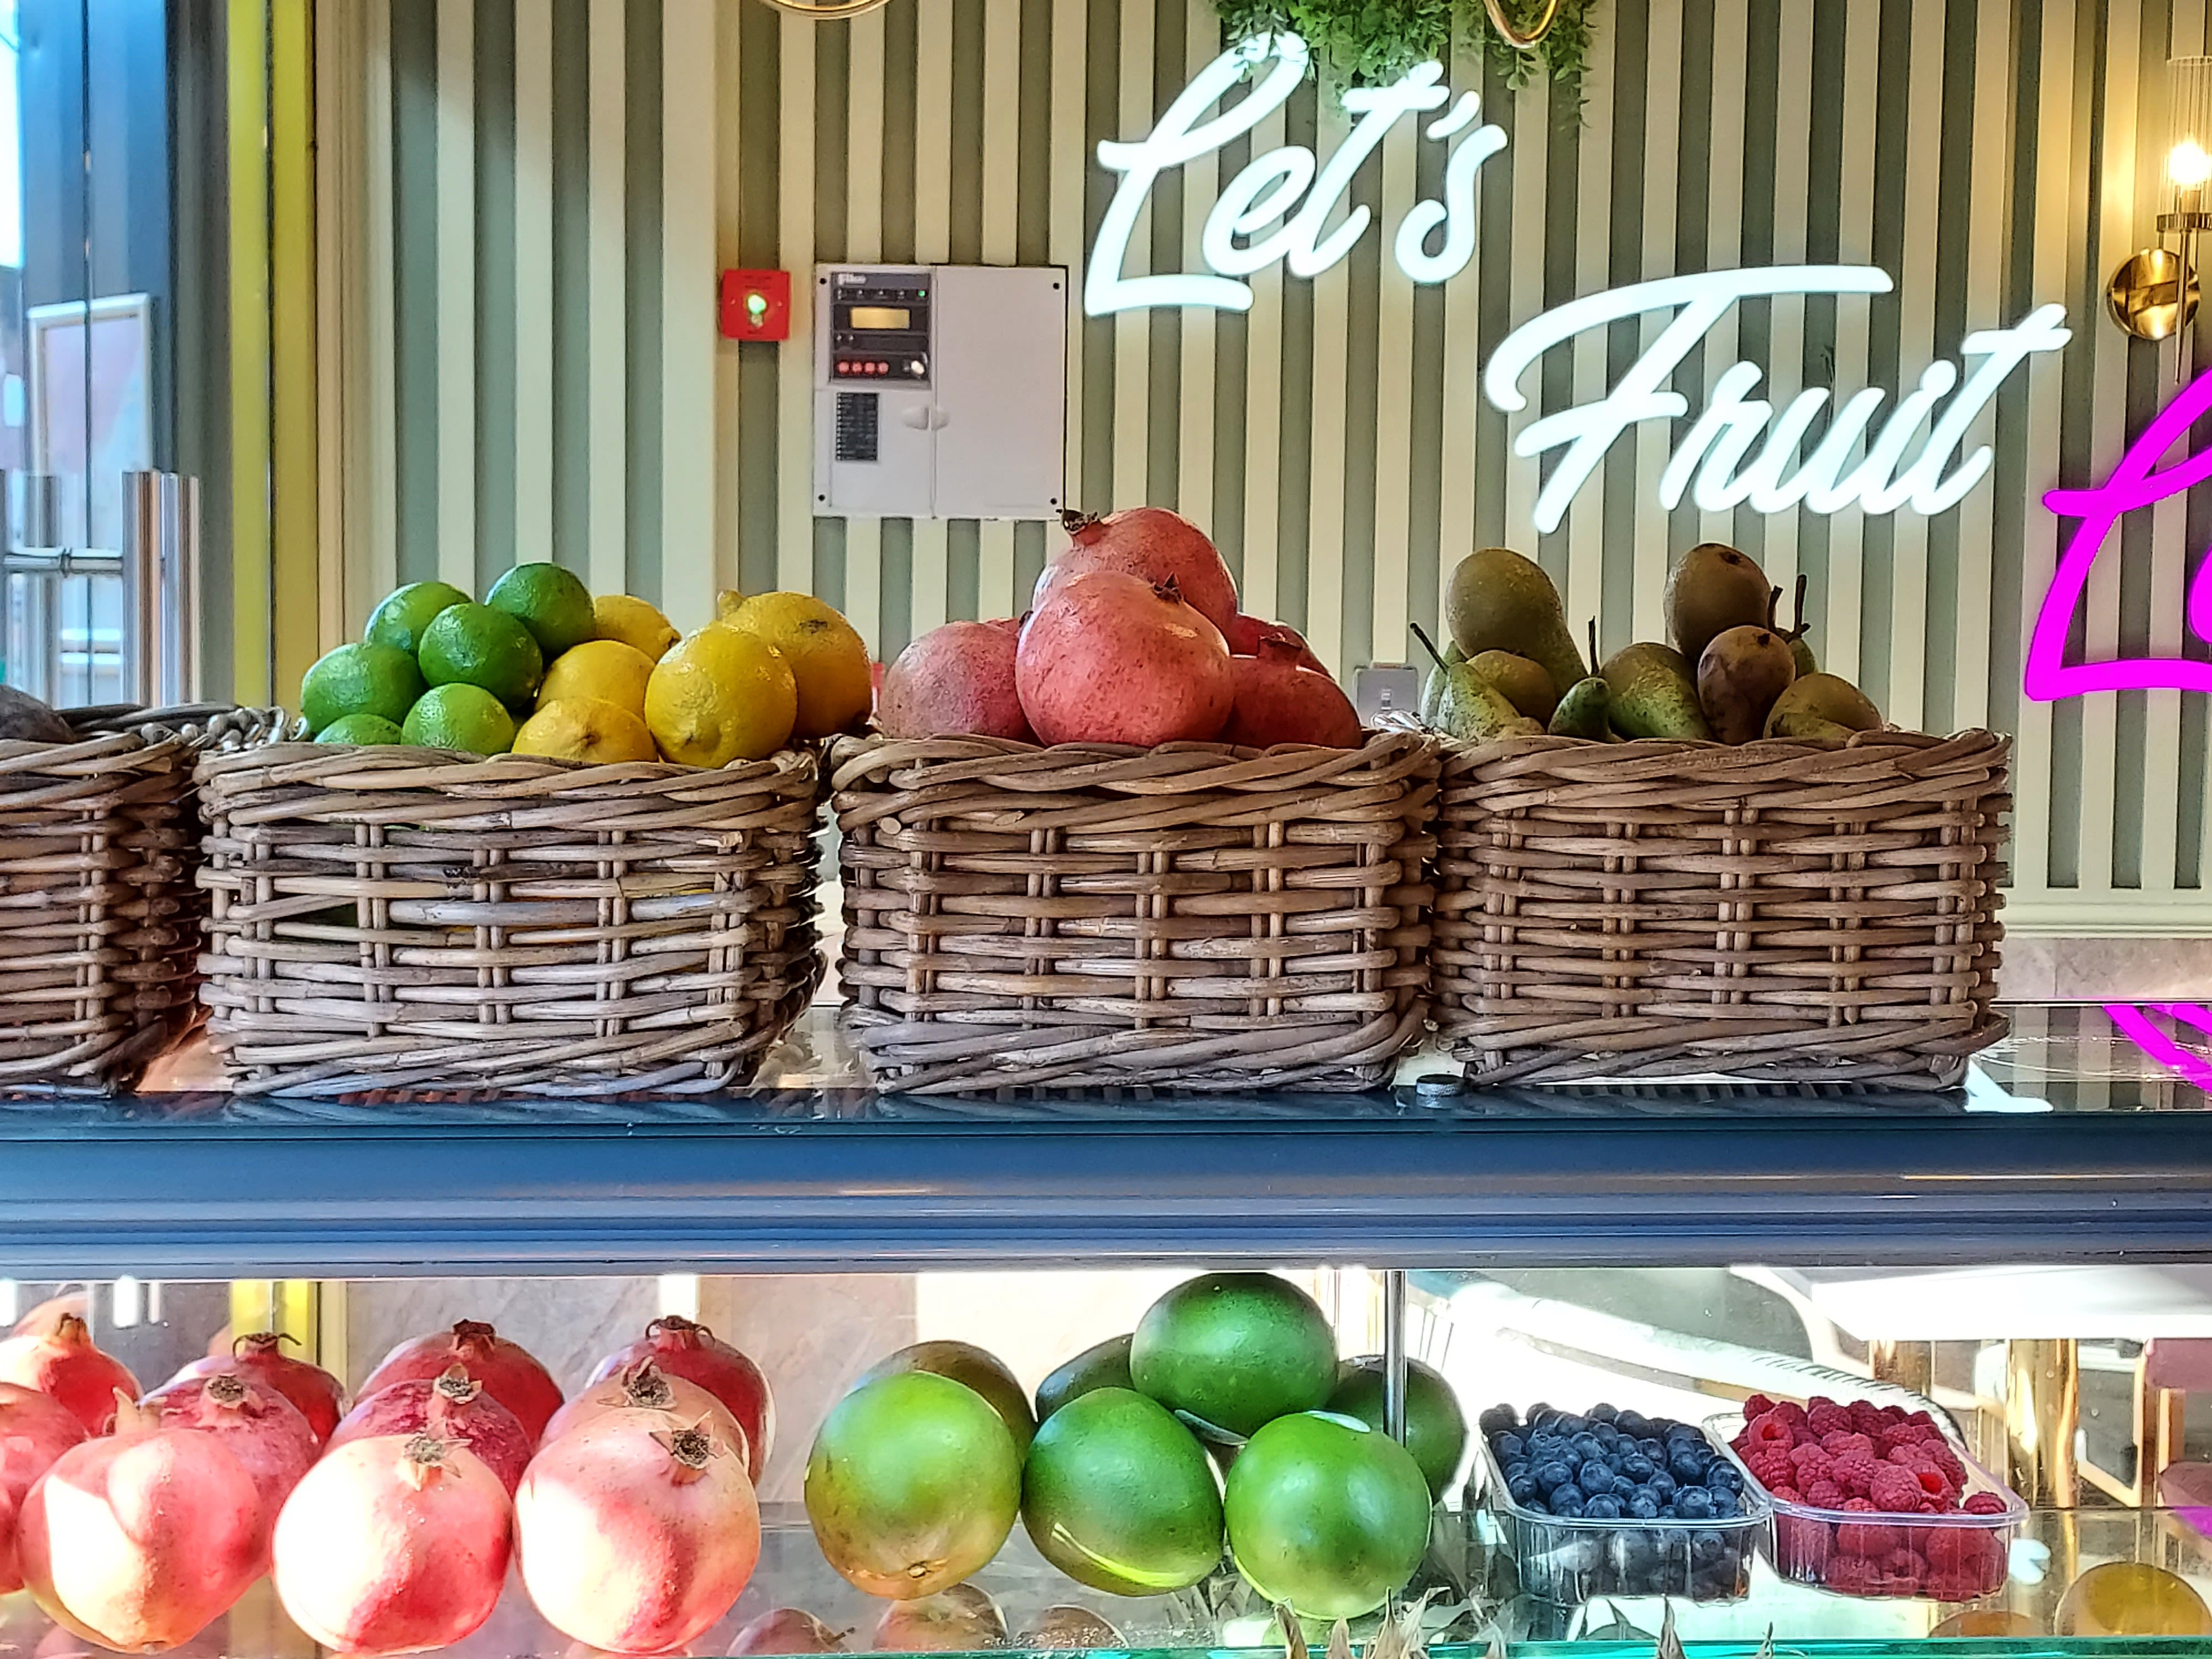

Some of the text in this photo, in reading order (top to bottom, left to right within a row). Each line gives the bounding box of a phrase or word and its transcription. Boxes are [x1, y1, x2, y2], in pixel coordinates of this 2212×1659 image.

[1084, 30, 1508, 317] Let's
[1484, 265, 2073, 534] Fruit
[2025, 366, 2212, 701] L
